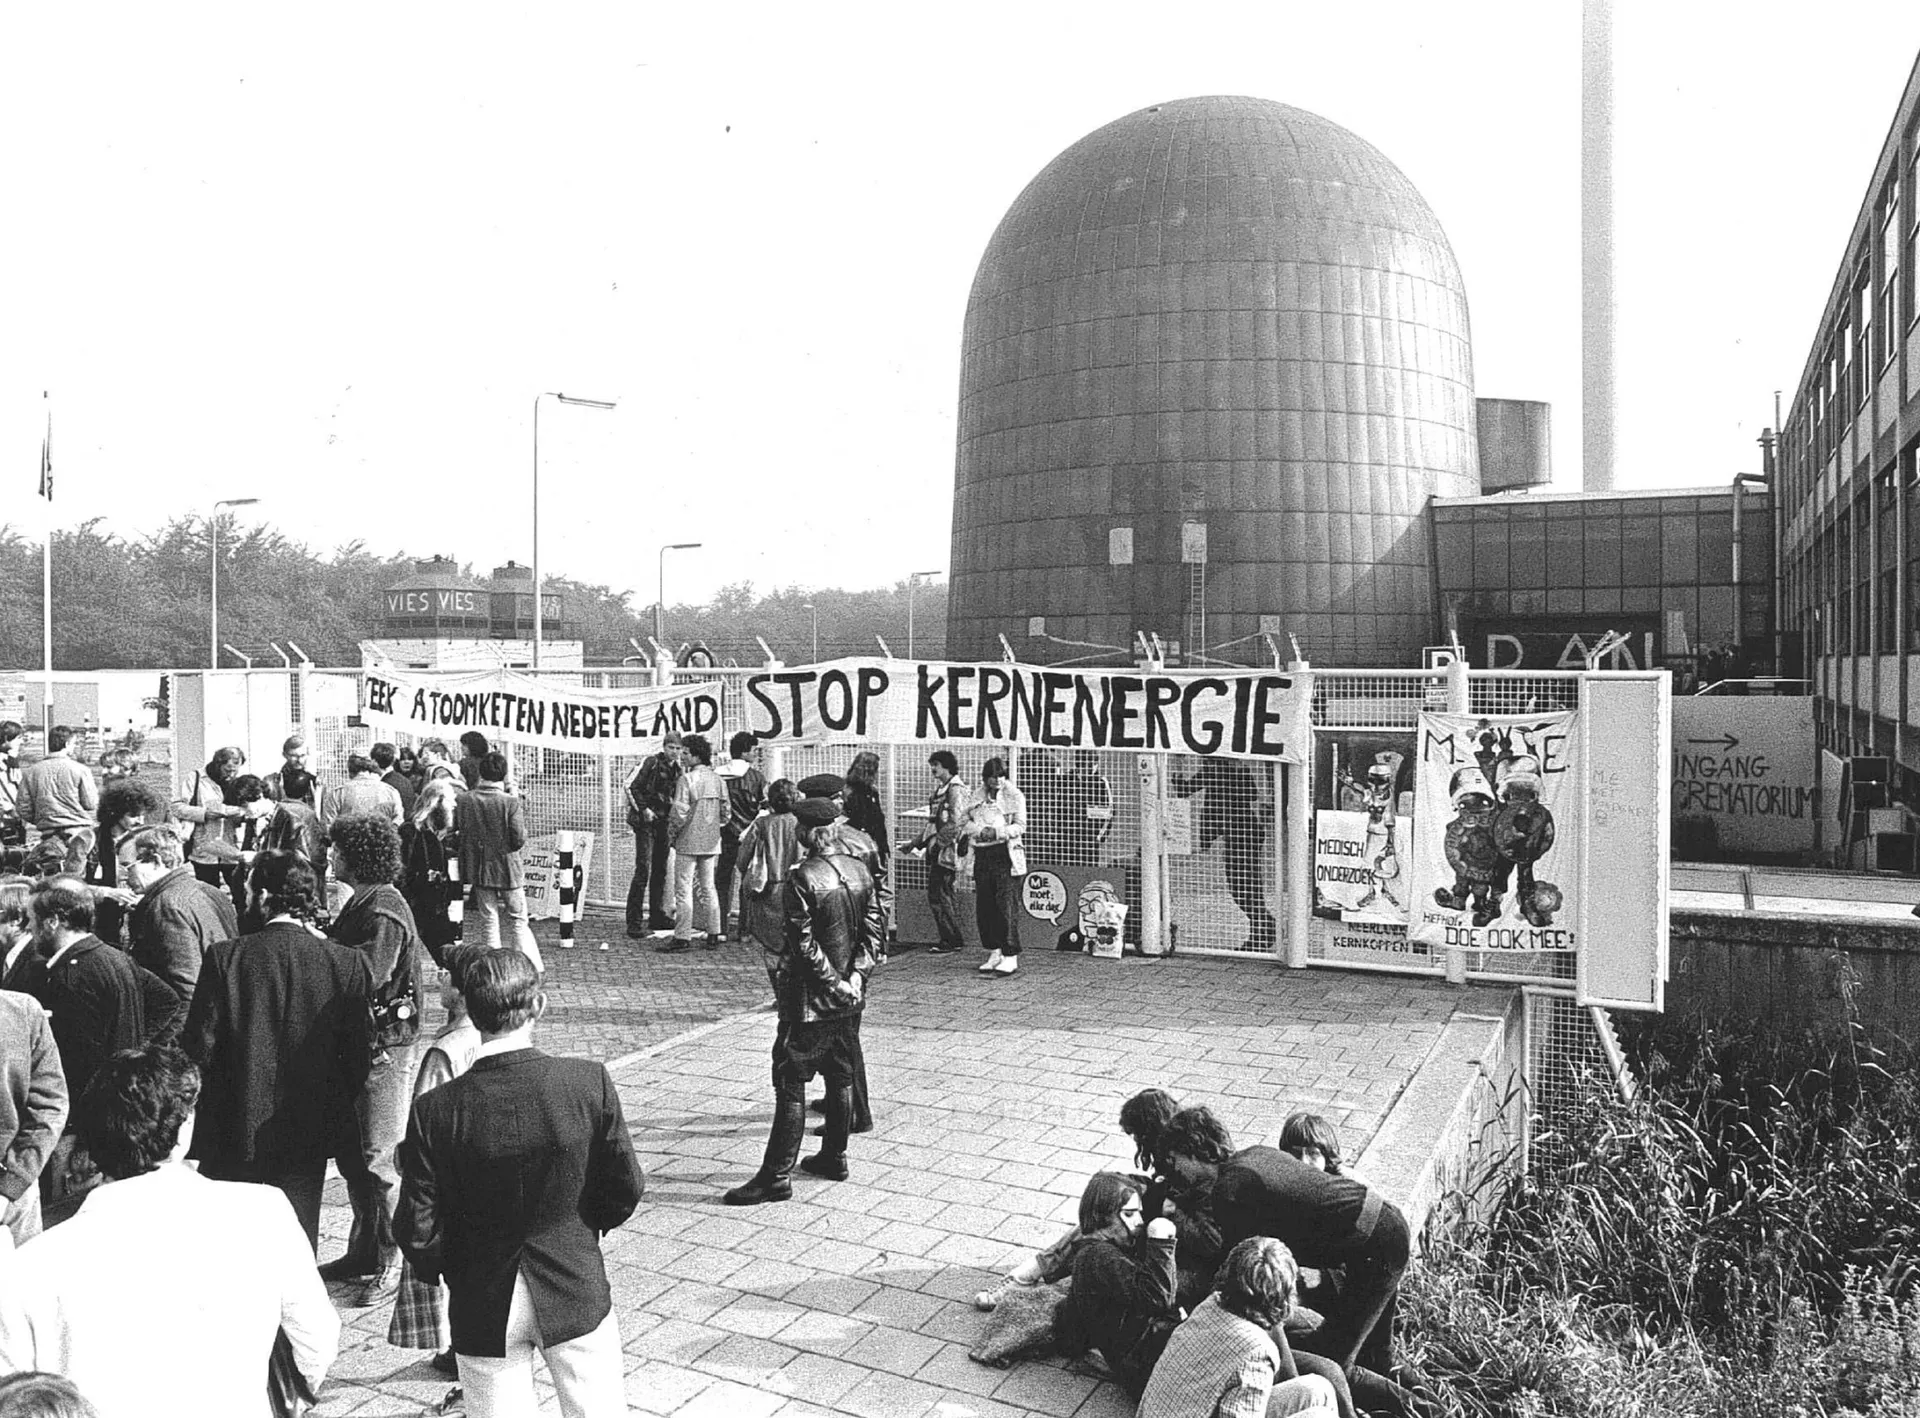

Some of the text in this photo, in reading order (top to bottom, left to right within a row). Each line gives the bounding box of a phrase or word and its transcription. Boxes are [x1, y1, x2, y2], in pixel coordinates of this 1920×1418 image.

[388, 590, 474, 612] VIES VIES
[746, 664, 1292, 755] STOP KERNENERGIE
[1318, 839, 1364, 858] MEDISCH
[1317, 864, 1377, 885] ONDERZOEK
[1333, 935, 1409, 954] KERNKOPPEN
[1445, 926, 1481, 948] DOE
[1488, 928, 1525, 949] OOK
